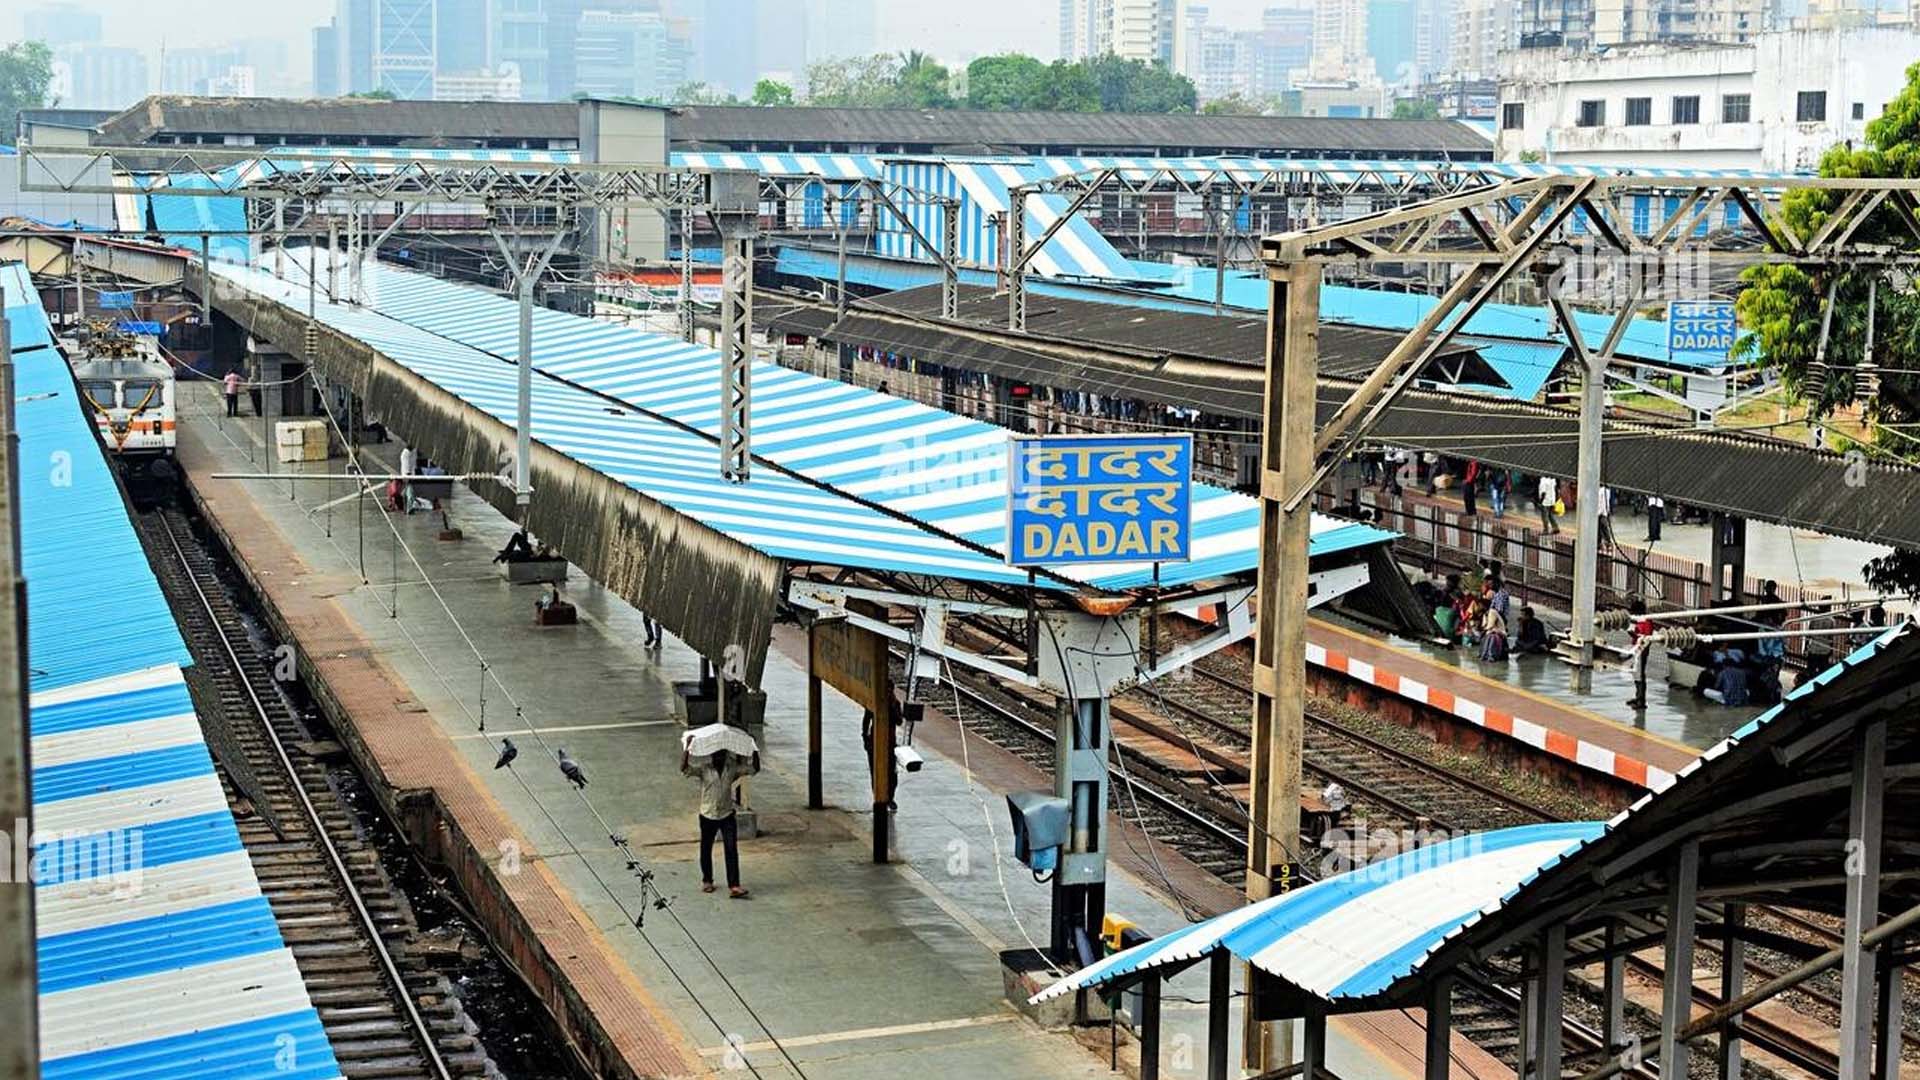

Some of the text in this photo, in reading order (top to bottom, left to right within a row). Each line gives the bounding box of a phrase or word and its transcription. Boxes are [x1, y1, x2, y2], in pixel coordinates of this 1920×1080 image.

[1673, 304, 1735, 318] दादर
[1673, 319, 1734, 333] दादर
[1673, 334, 1733, 349] DADAR
[1022, 444, 1182, 480] दादर
[1022, 482, 1182, 519] दादर
[1023, 520, 1181, 557] DADAR
[1281, 864, 1290, 877] 9
